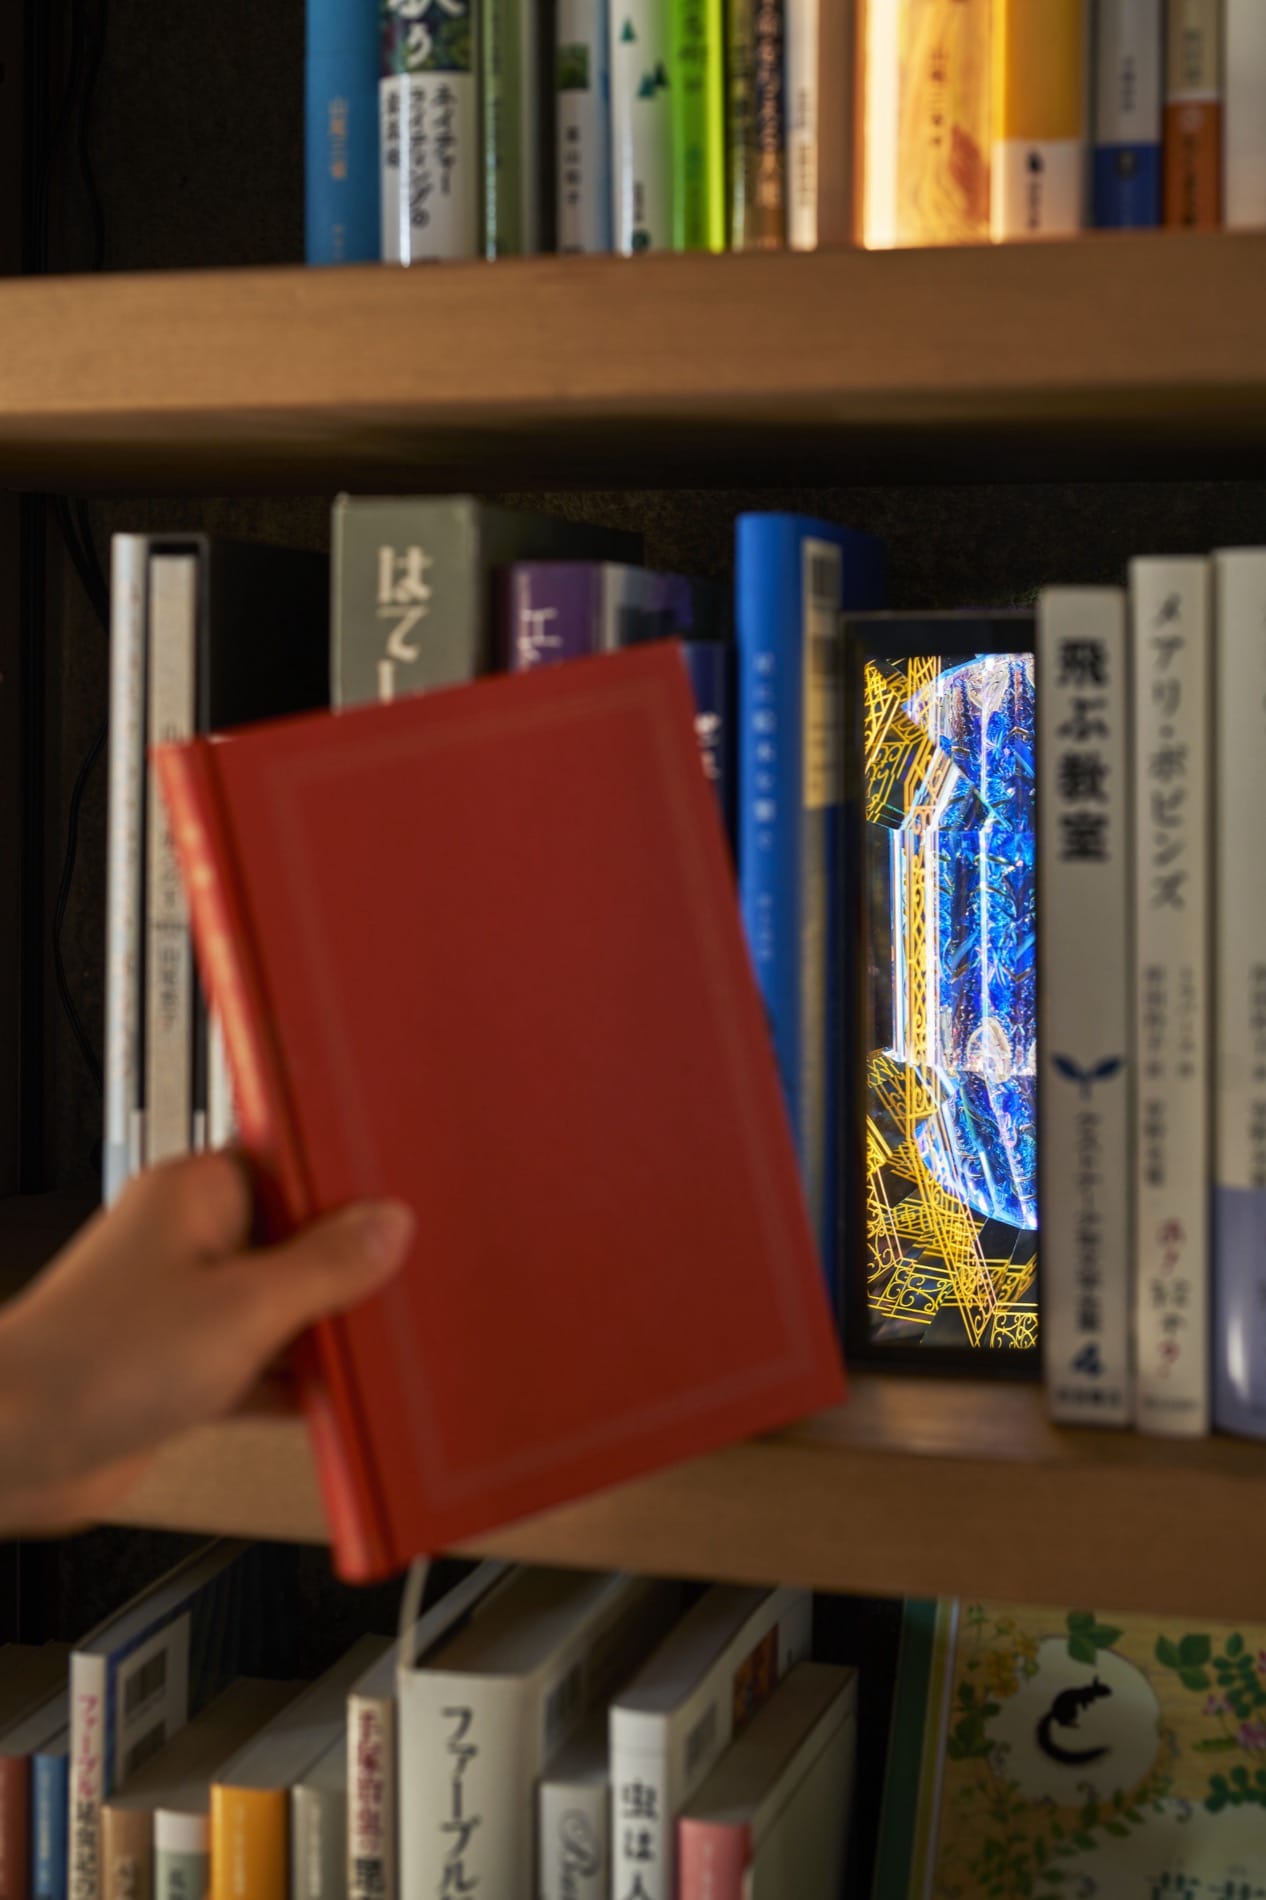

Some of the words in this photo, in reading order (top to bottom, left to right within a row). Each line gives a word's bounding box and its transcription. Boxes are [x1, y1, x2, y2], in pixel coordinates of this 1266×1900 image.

[1056, 638, 1109, 864] 飛ぶ教室
[437, 1706, 482, 1900] ファーブル
[621, 1780, 659, 1900] 虫は人
